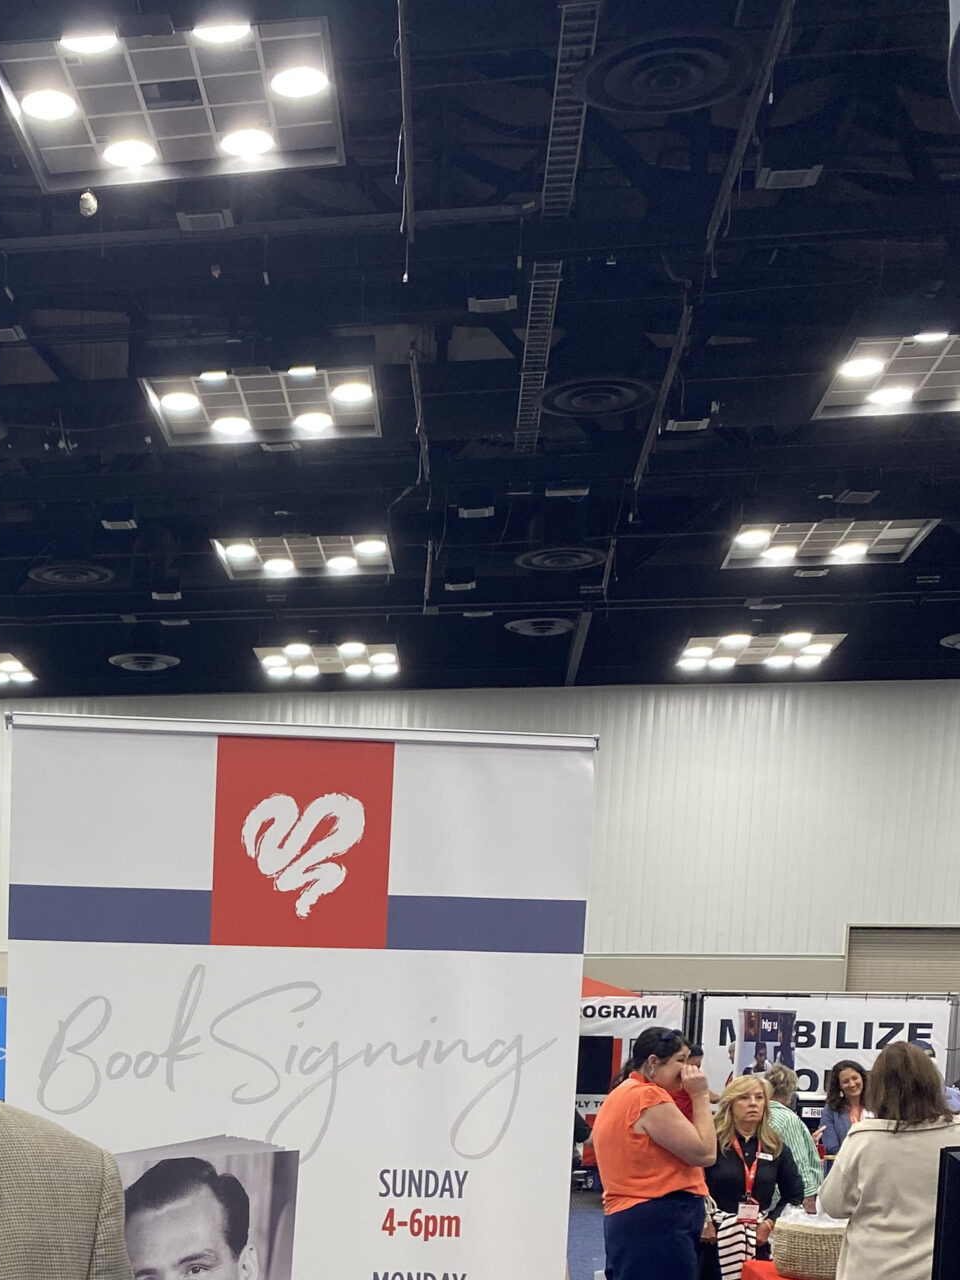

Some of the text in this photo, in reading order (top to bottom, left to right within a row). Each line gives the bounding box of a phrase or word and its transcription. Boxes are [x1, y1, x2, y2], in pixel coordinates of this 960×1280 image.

[581, 1005, 657, 1018] OGRAM
[719, 1019, 933, 1049] BILIZE
[37, 964, 558, 1163] Book Signing
[379, 1169, 468, 1198] SUNDAY
[382, 1209, 460, 1241] 4-6pm
